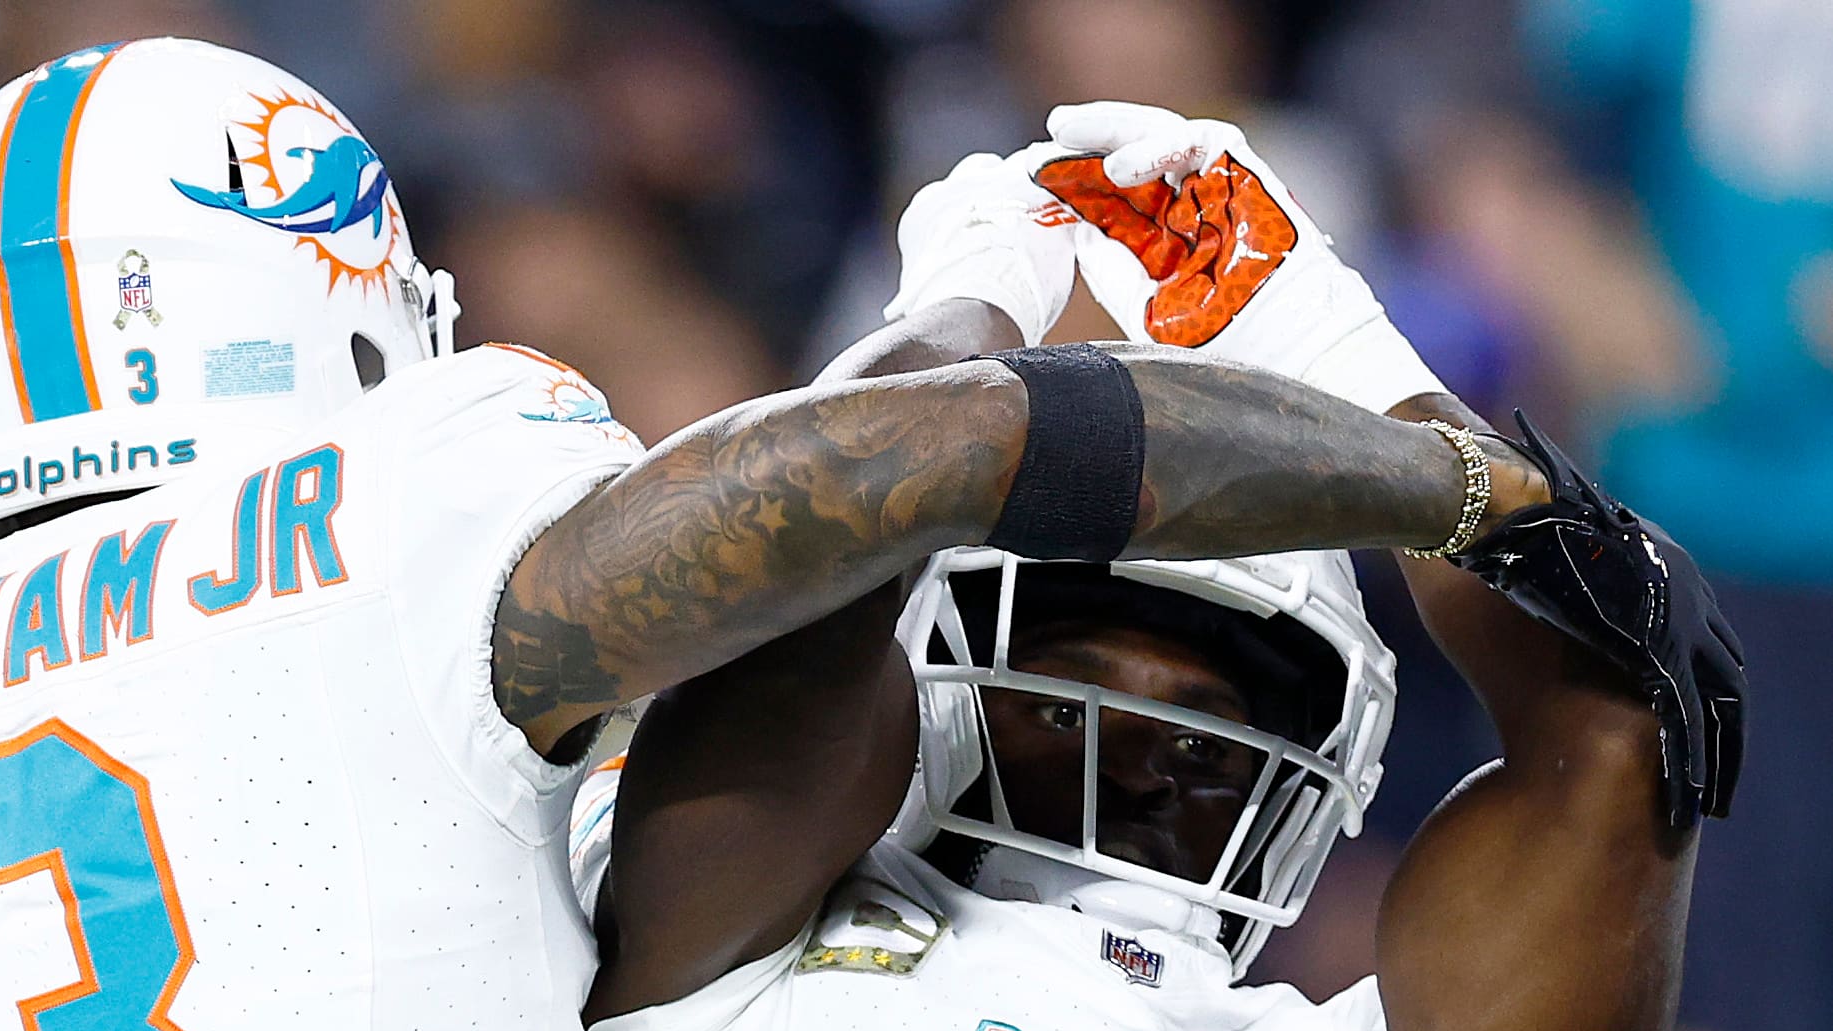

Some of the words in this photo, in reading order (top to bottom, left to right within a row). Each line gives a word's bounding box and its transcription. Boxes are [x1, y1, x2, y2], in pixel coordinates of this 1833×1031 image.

[123, 288, 150, 308] NFL
[124, 347, 160, 405] 3
[187, 441, 349, 617] JR
[1112, 945, 1154, 978] NFL
